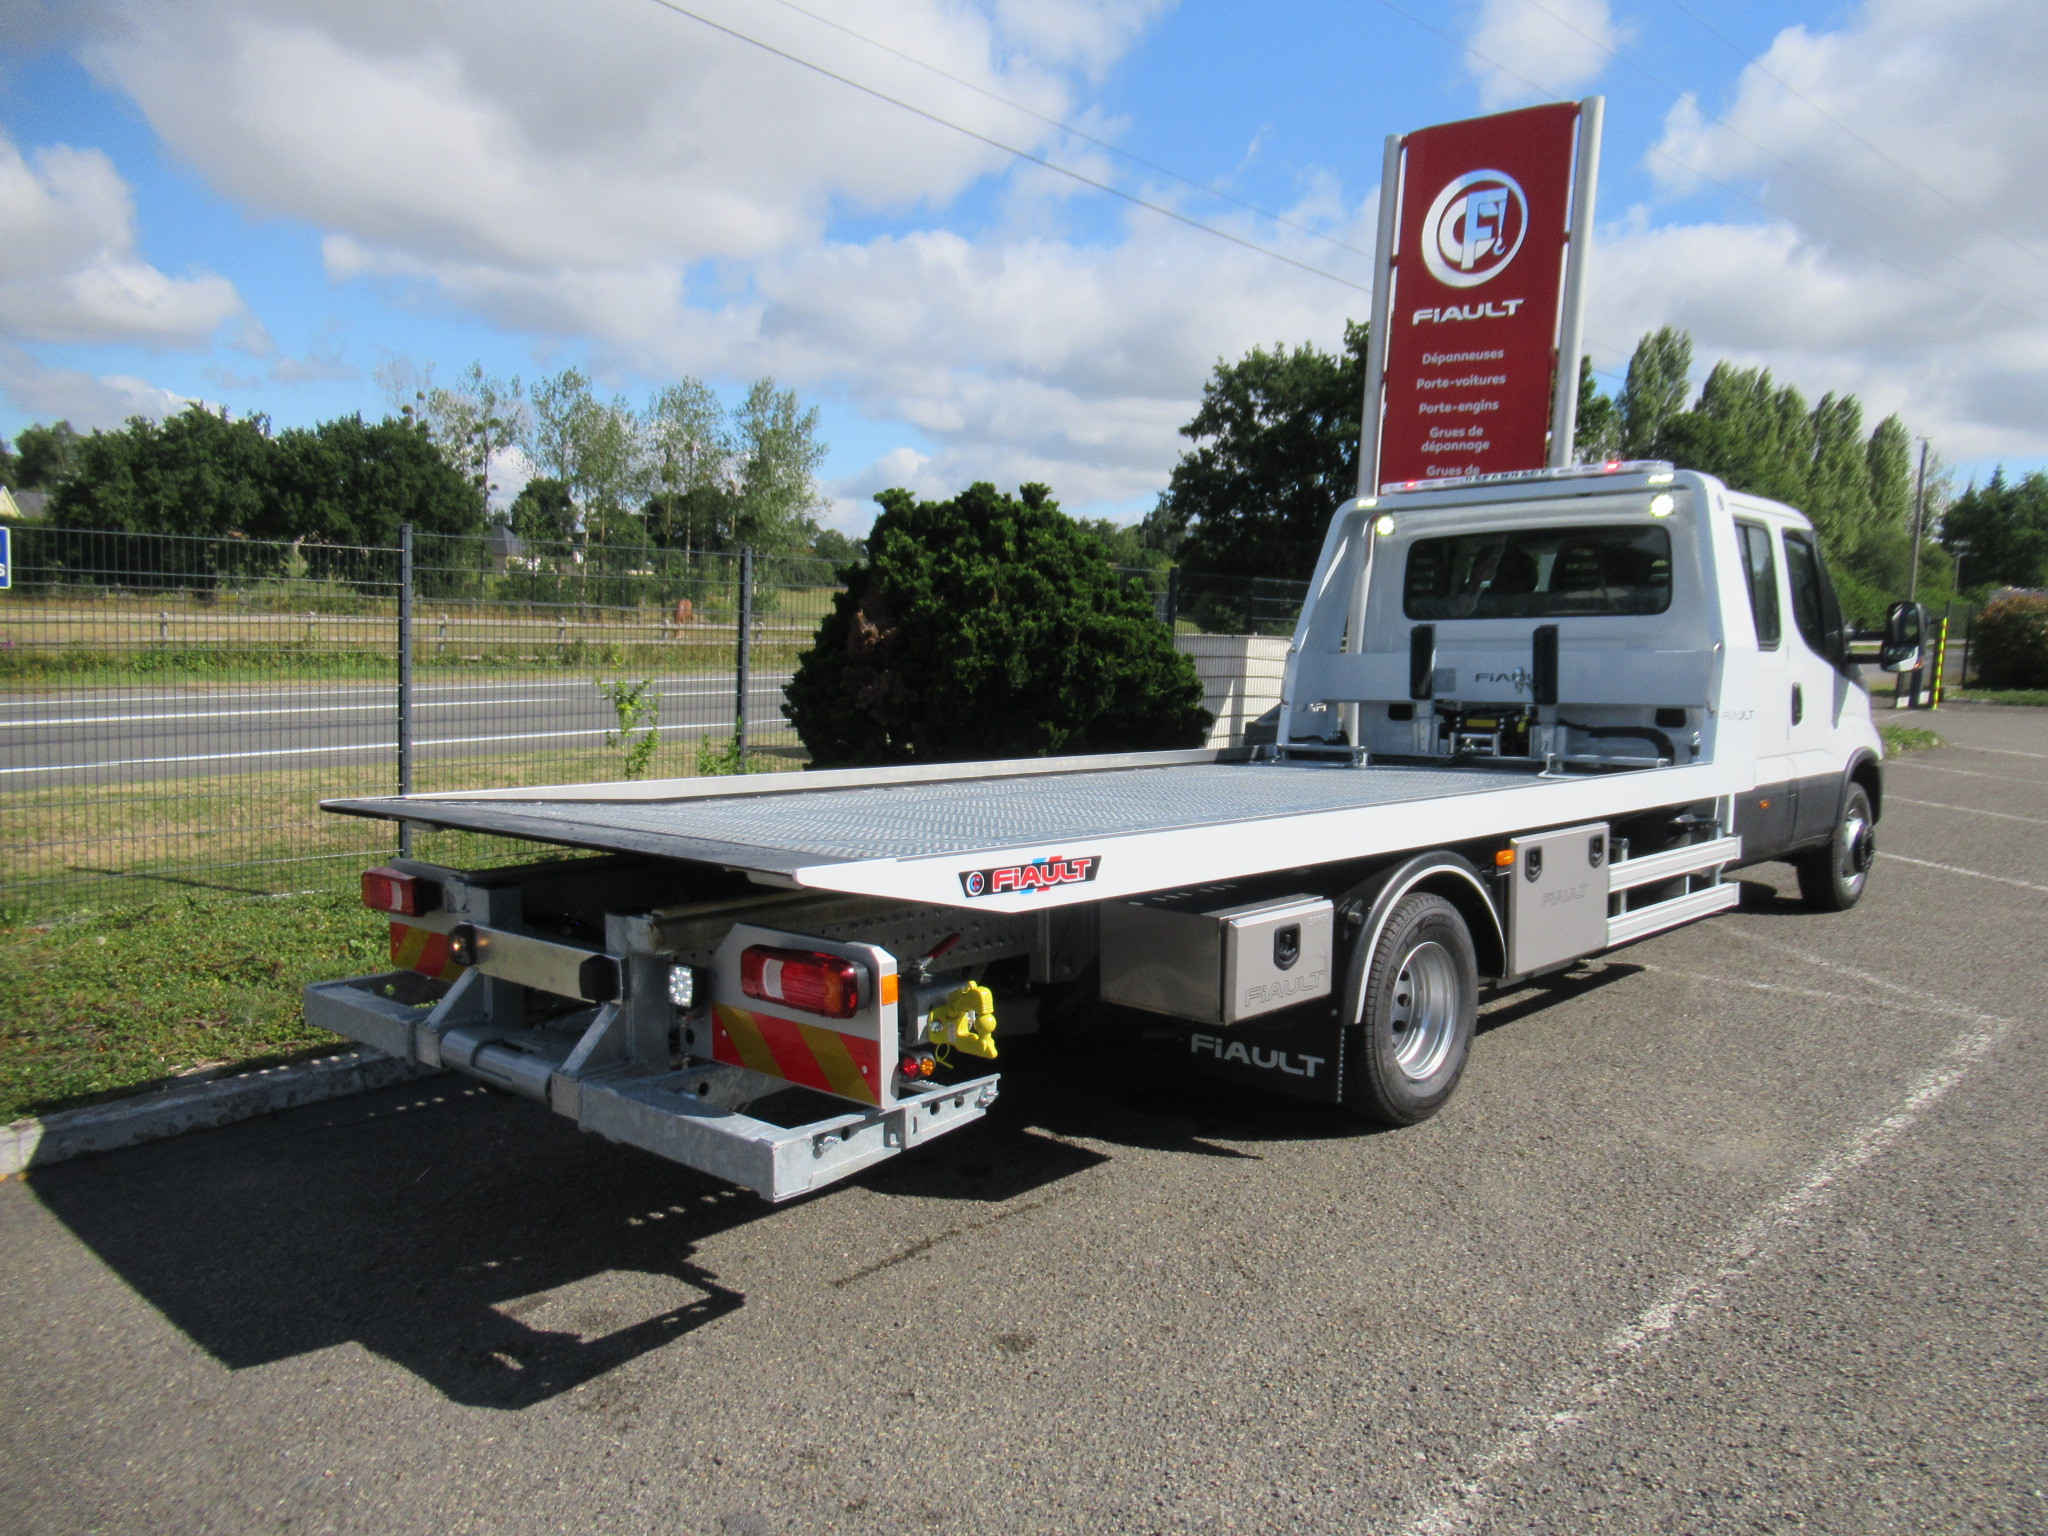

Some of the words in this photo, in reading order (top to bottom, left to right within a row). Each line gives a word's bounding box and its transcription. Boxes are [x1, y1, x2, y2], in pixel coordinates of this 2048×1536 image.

[1412, 299, 1525, 326] FIAULT
[1422, 349, 1504, 366] Dépanneuses
[1416, 374, 1507, 390] Porte-voitures
[1419, 399, 1499, 415] Porte-engins
[1429, 426, 1465, 438] Grues
[1468, 425, 1484, 436] de
[1421, 440, 1490, 454] dépannage
[1426, 465, 1462, 477] Grues
[1465, 464, 1480, 475] de
[992, 858, 1092, 892] FIAULT
[1244, 970, 1325, 1007] FIAULT
[1190, 1033, 1325, 1078] FIAULT
